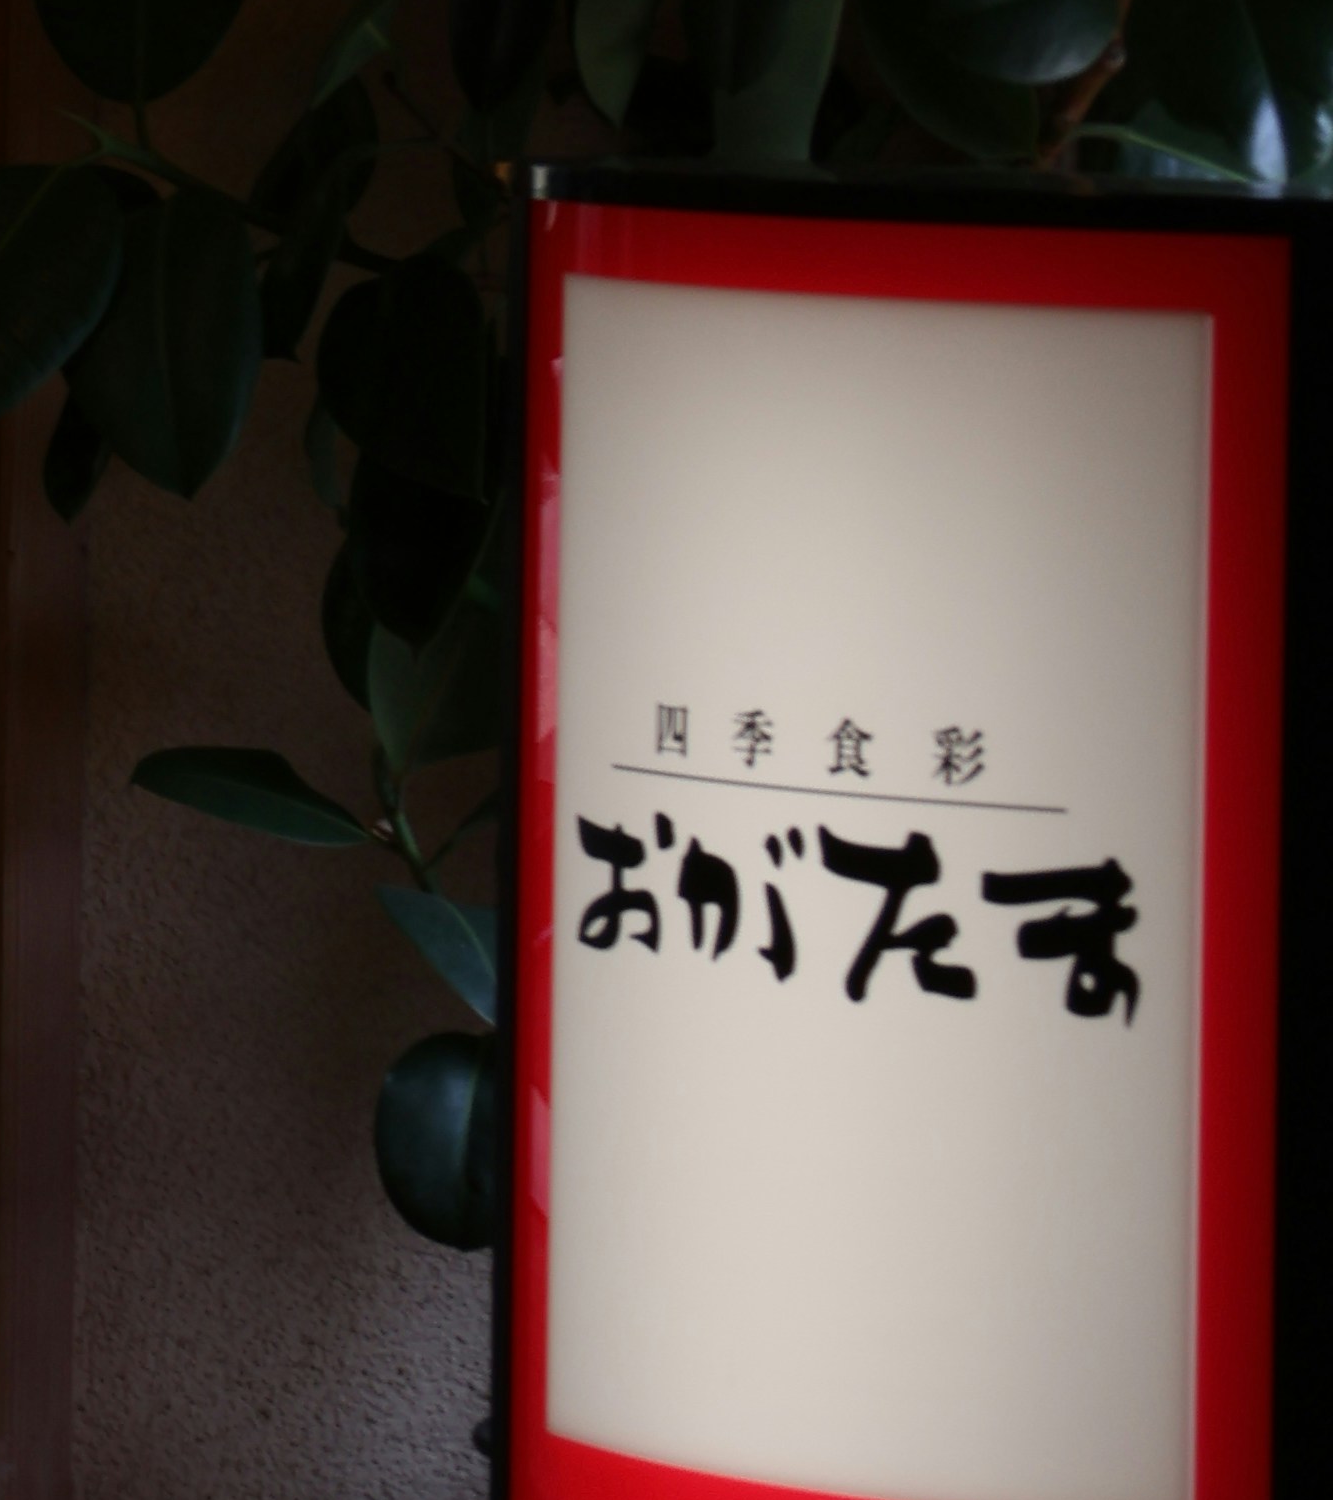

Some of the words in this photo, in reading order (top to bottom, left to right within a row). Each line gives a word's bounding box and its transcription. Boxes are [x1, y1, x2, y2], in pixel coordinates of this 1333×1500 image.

[654, 701, 987, 788] 四季食彩
[576, 810, 1141, 1029] おがたま
